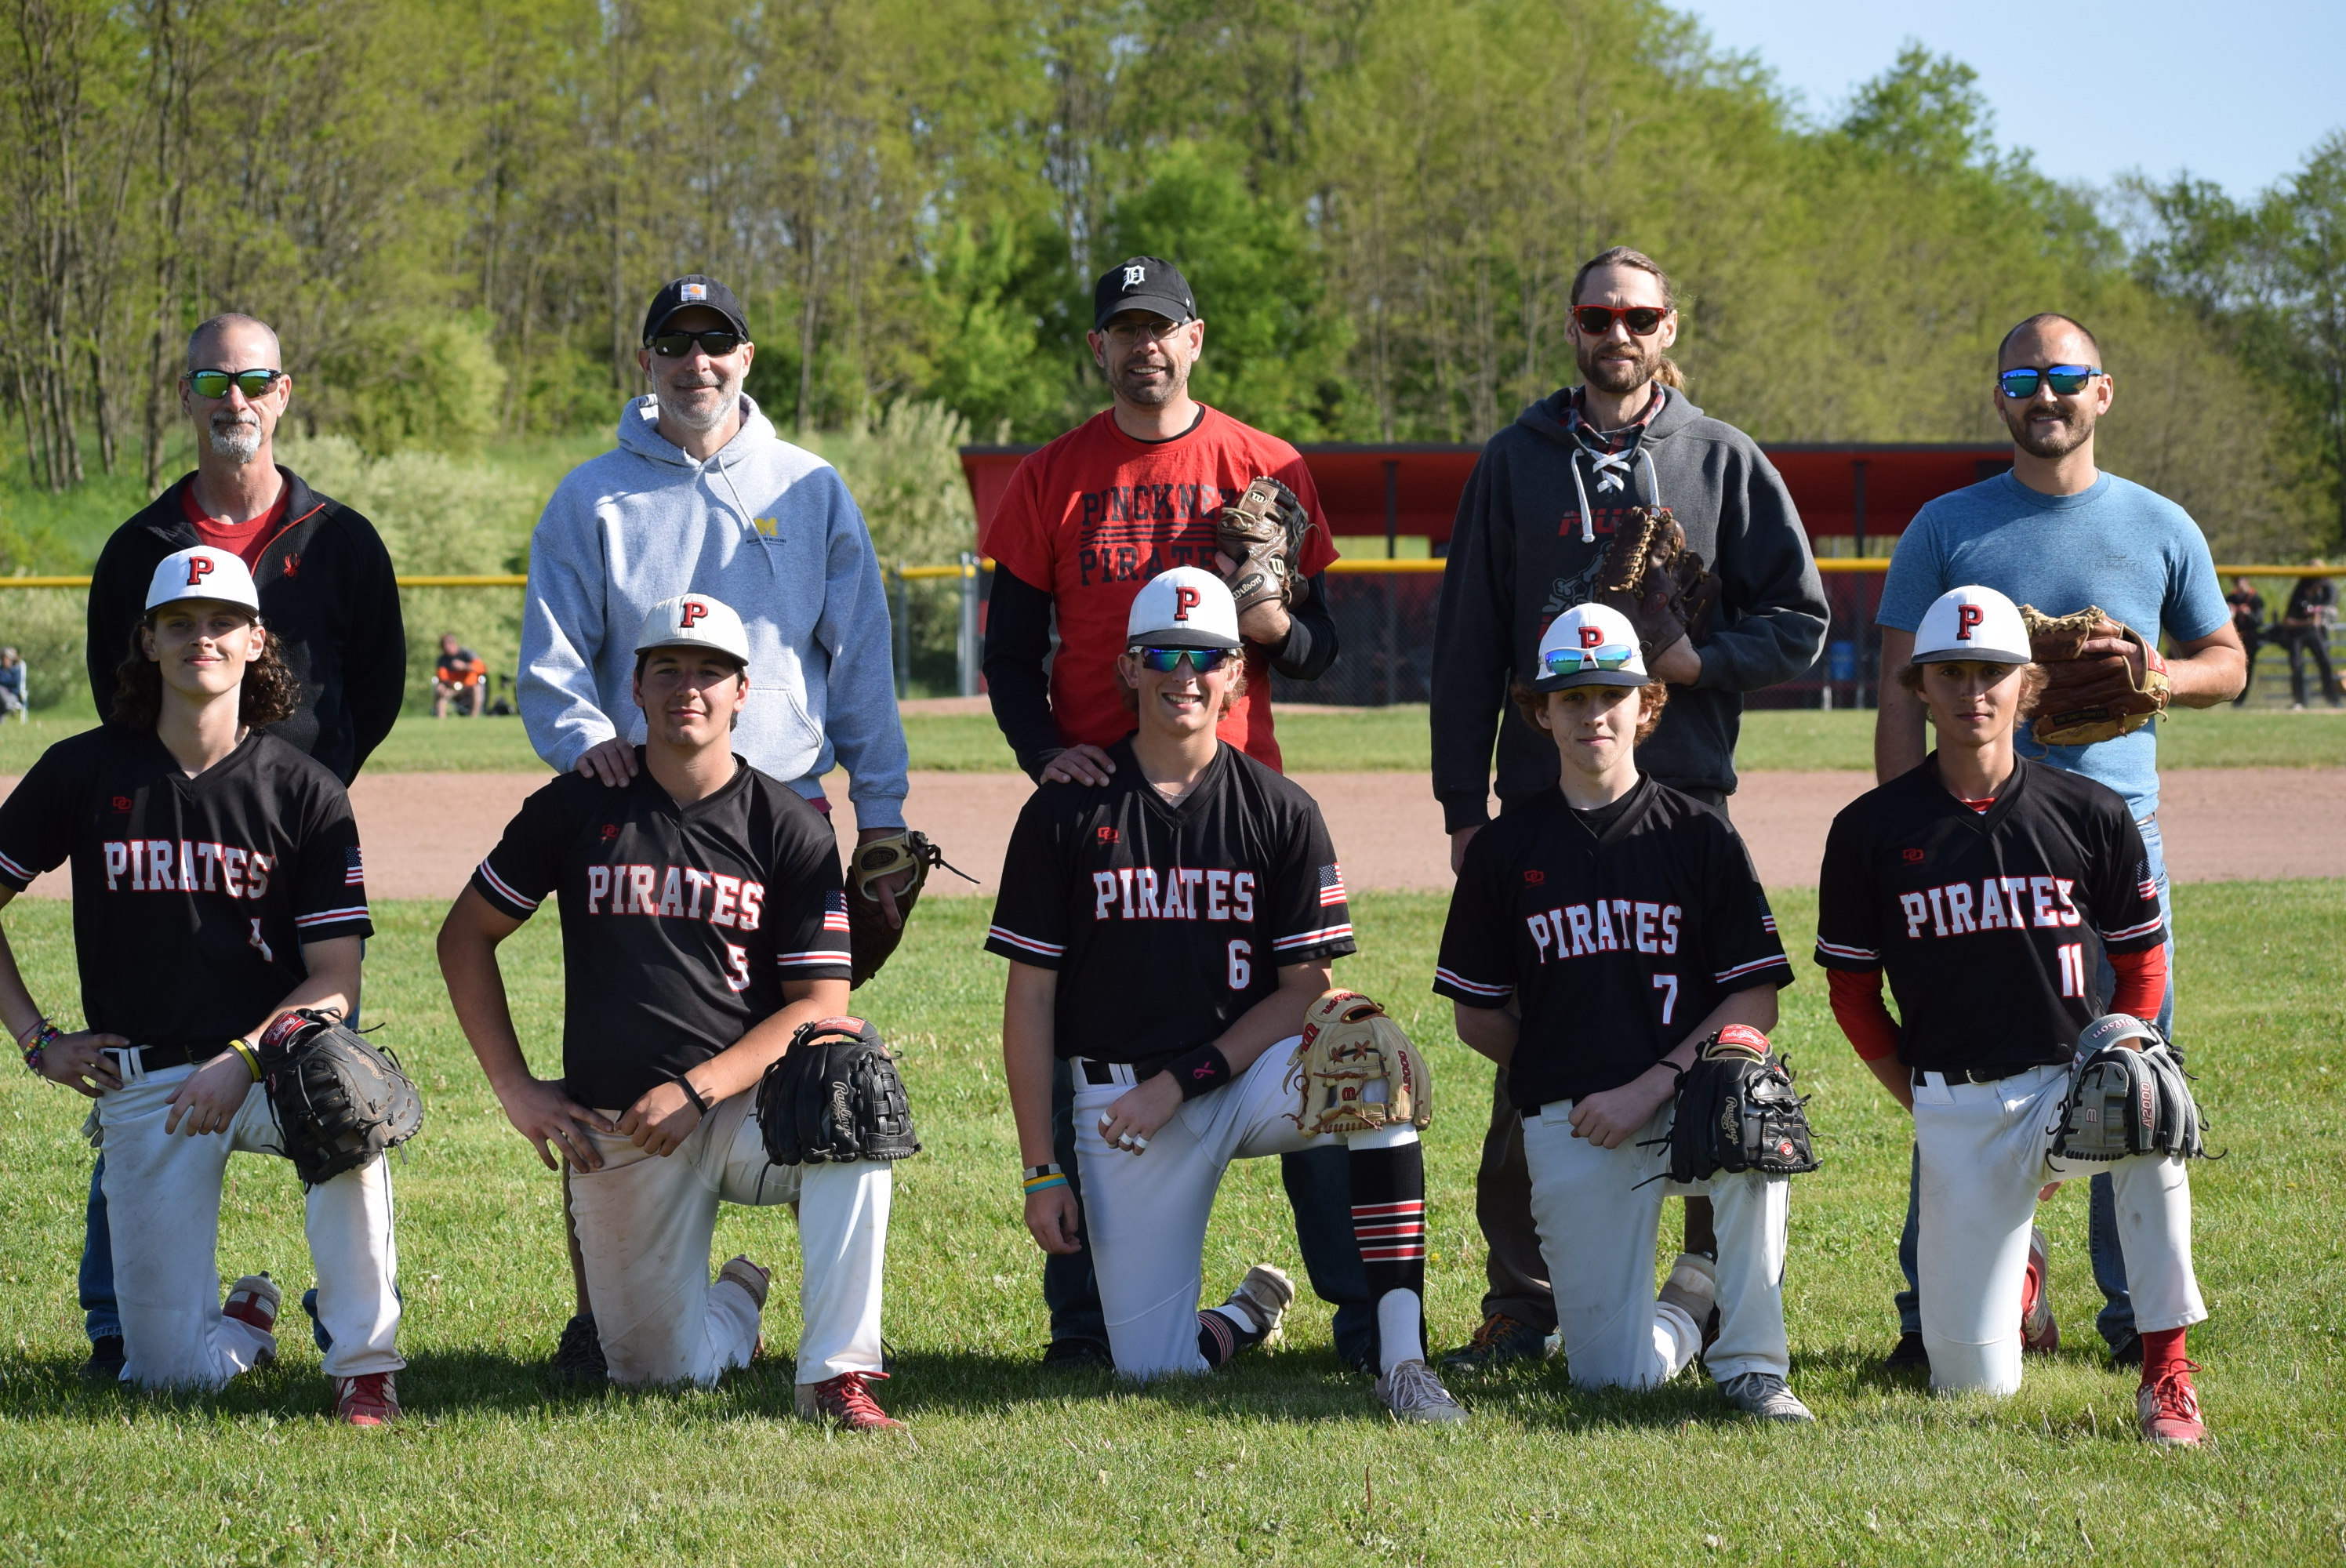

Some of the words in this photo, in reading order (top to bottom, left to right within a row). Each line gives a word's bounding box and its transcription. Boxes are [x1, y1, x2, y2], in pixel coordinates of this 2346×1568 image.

[1122, 265, 1145, 292] D
[754, 517, 778, 537] M
[187, 556, 214, 585] P
[1078, 546, 1218, 586] PIRATE
[1232, 575, 1263, 601] Wilson
[680, 601, 709, 628] P
[1175, 586, 1200, 621] P
[1957, 604, 1983, 640] P
[1578, 626, 1605, 661] P
[102, 839, 274, 900] PIRATES
[588, 866, 765, 931] PIRATES
[1093, 867, 1255, 923] PIRATES
[1899, 875, 2082, 939] PIRATES
[1526, 898, 1683, 964] PIRATES
[726, 944, 751, 992] 5
[1227, 940, 1252, 990] 6
[2057, 943, 2084, 998] 11
[1652, 973, 1679, 1025] 7
[2091, 1018, 2143, 1039] Wilson
[1398, 1051, 1412, 1095] A2000
[832, 1081, 854, 1138] Rawlings
[1725, 1096, 1740, 1146] Rawlings
[2140, 1081, 2155, 1129] A2000
